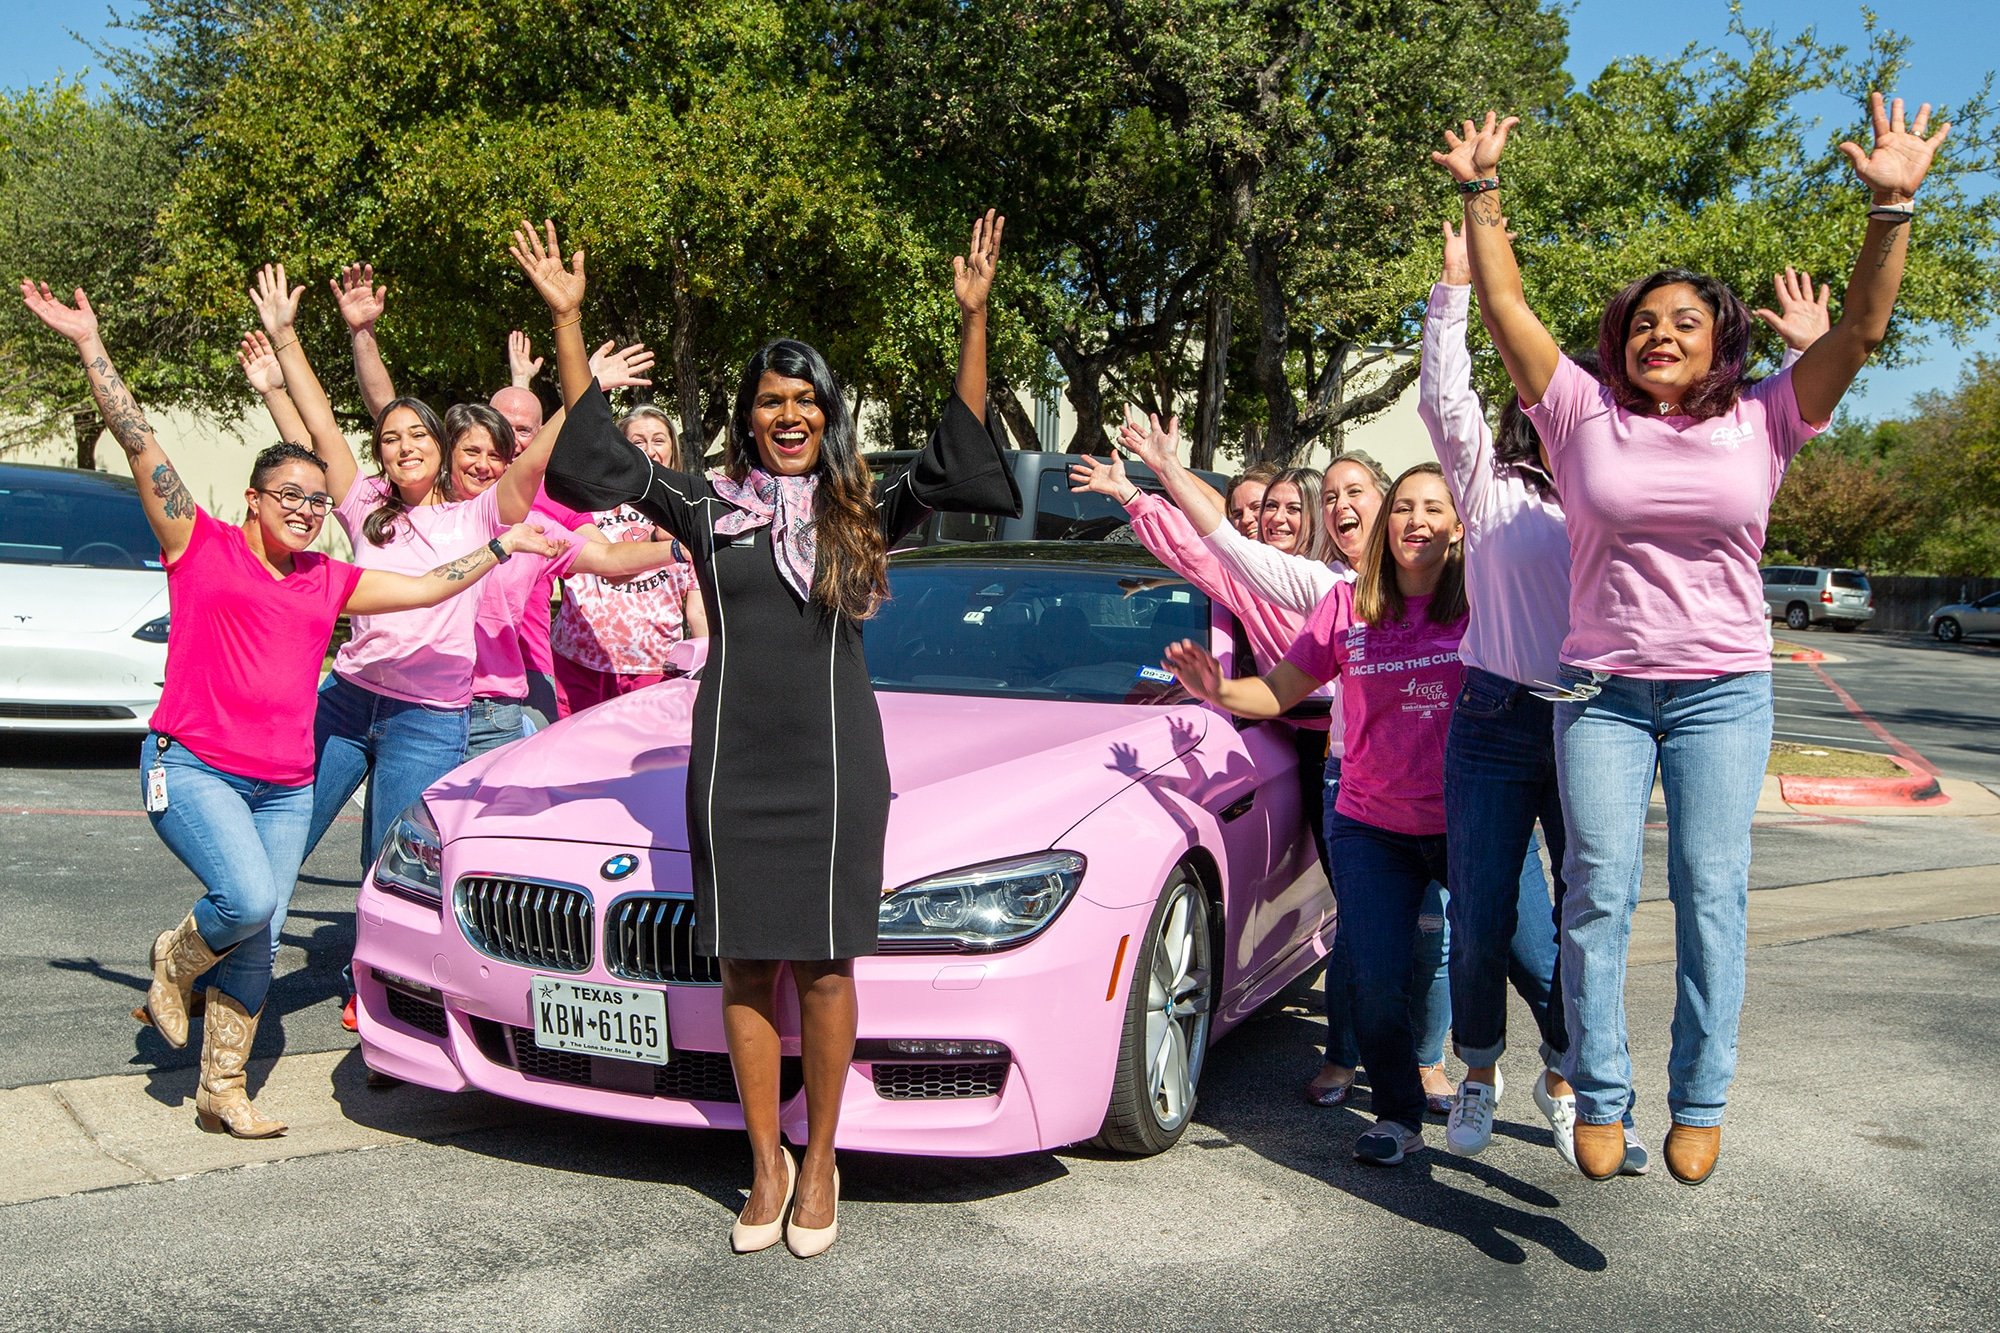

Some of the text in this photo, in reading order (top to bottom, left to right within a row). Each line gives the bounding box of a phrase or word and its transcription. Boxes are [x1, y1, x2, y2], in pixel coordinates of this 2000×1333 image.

[1347, 648, 1365, 662] BE
[1349, 652, 1460, 676] RACE FOR THE CUR
[1415, 684, 1444, 695] race
[1426, 691, 1448, 700] cure
[571, 986, 623, 1005] TEXAS
[540, 1001, 658, 1048] KBW 6165
[614, 1047, 632, 1055] State
